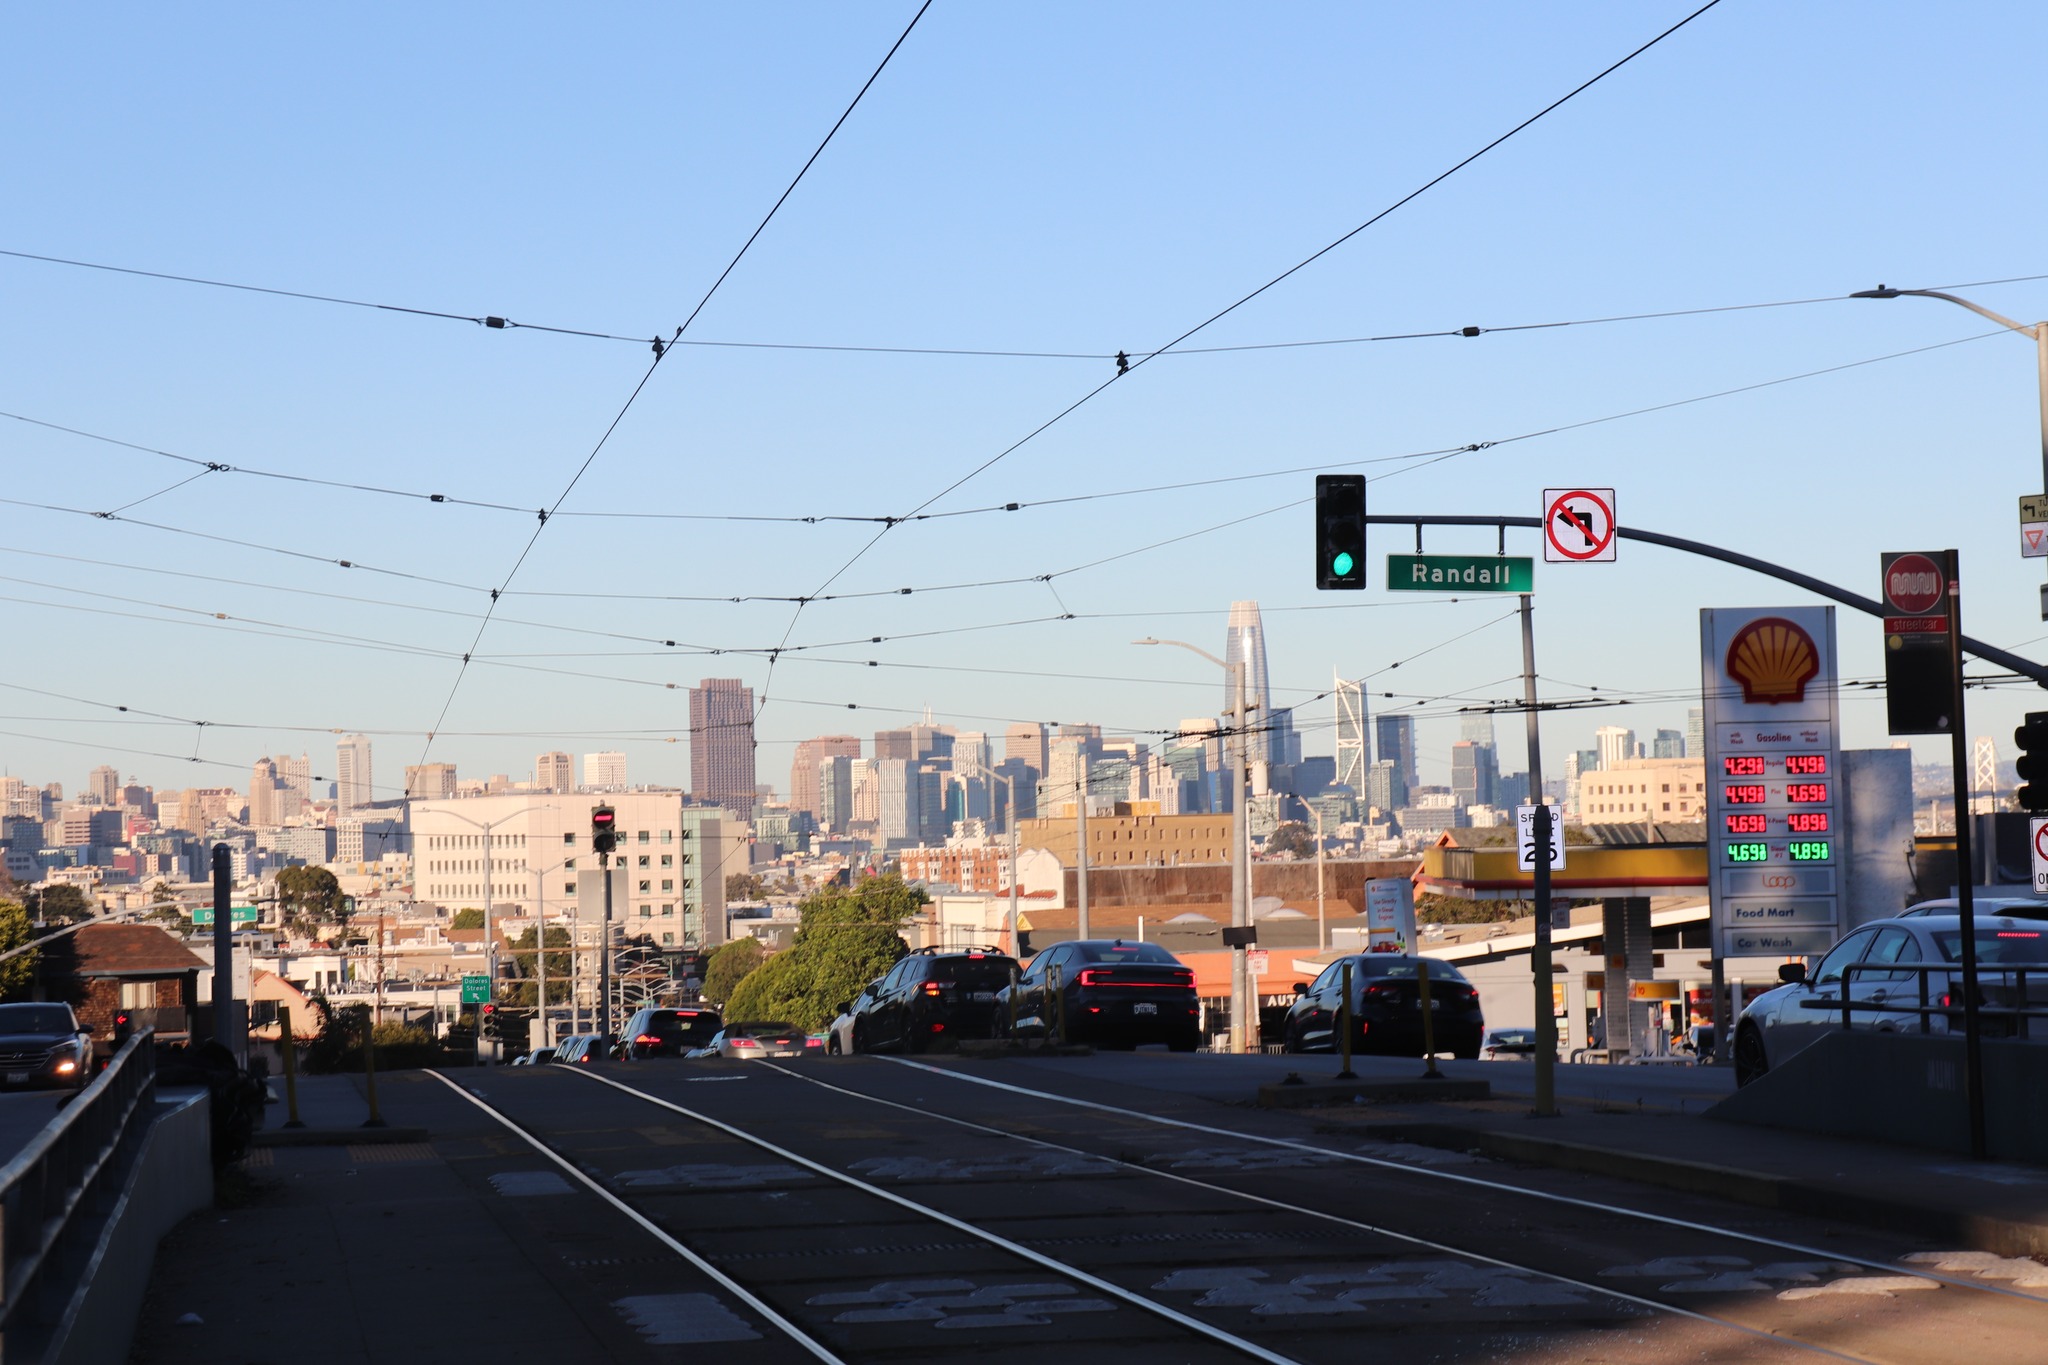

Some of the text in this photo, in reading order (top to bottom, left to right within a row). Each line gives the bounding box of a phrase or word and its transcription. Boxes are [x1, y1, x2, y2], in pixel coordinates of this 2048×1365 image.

[1412, 563, 1510, 584] Randall
[1891, 572, 1937, 596] MUNI
[1893, 619, 1937, 631] streetcar
[1756, 732, 1792, 743] Gasoline
[1736, 908, 1795, 918] Food Mart
[1737, 937, 1792, 948] Car Wash
